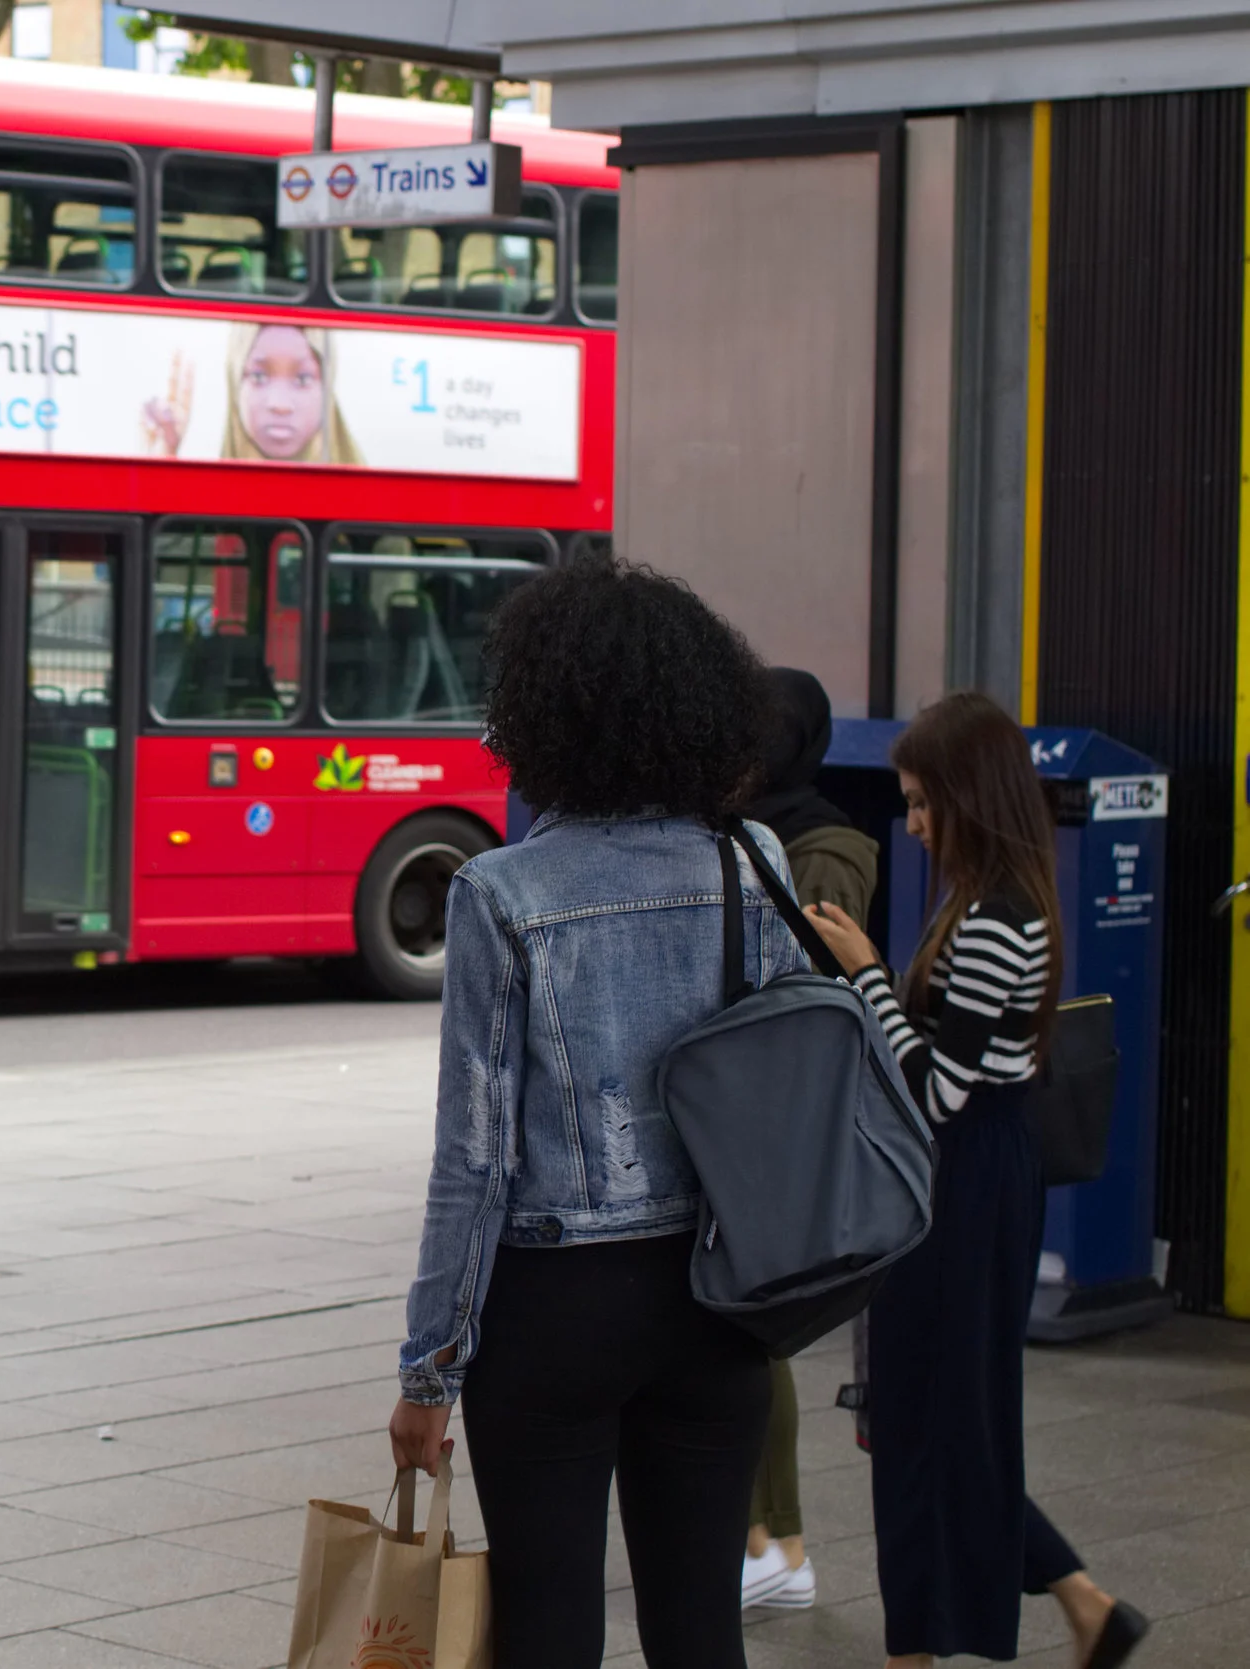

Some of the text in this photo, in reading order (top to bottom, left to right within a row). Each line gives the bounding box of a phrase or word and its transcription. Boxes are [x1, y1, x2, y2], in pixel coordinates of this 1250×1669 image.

[462, 377, 494, 398] day
[445, 403, 522, 428] changes
[443, 429, 486, 449] lives
